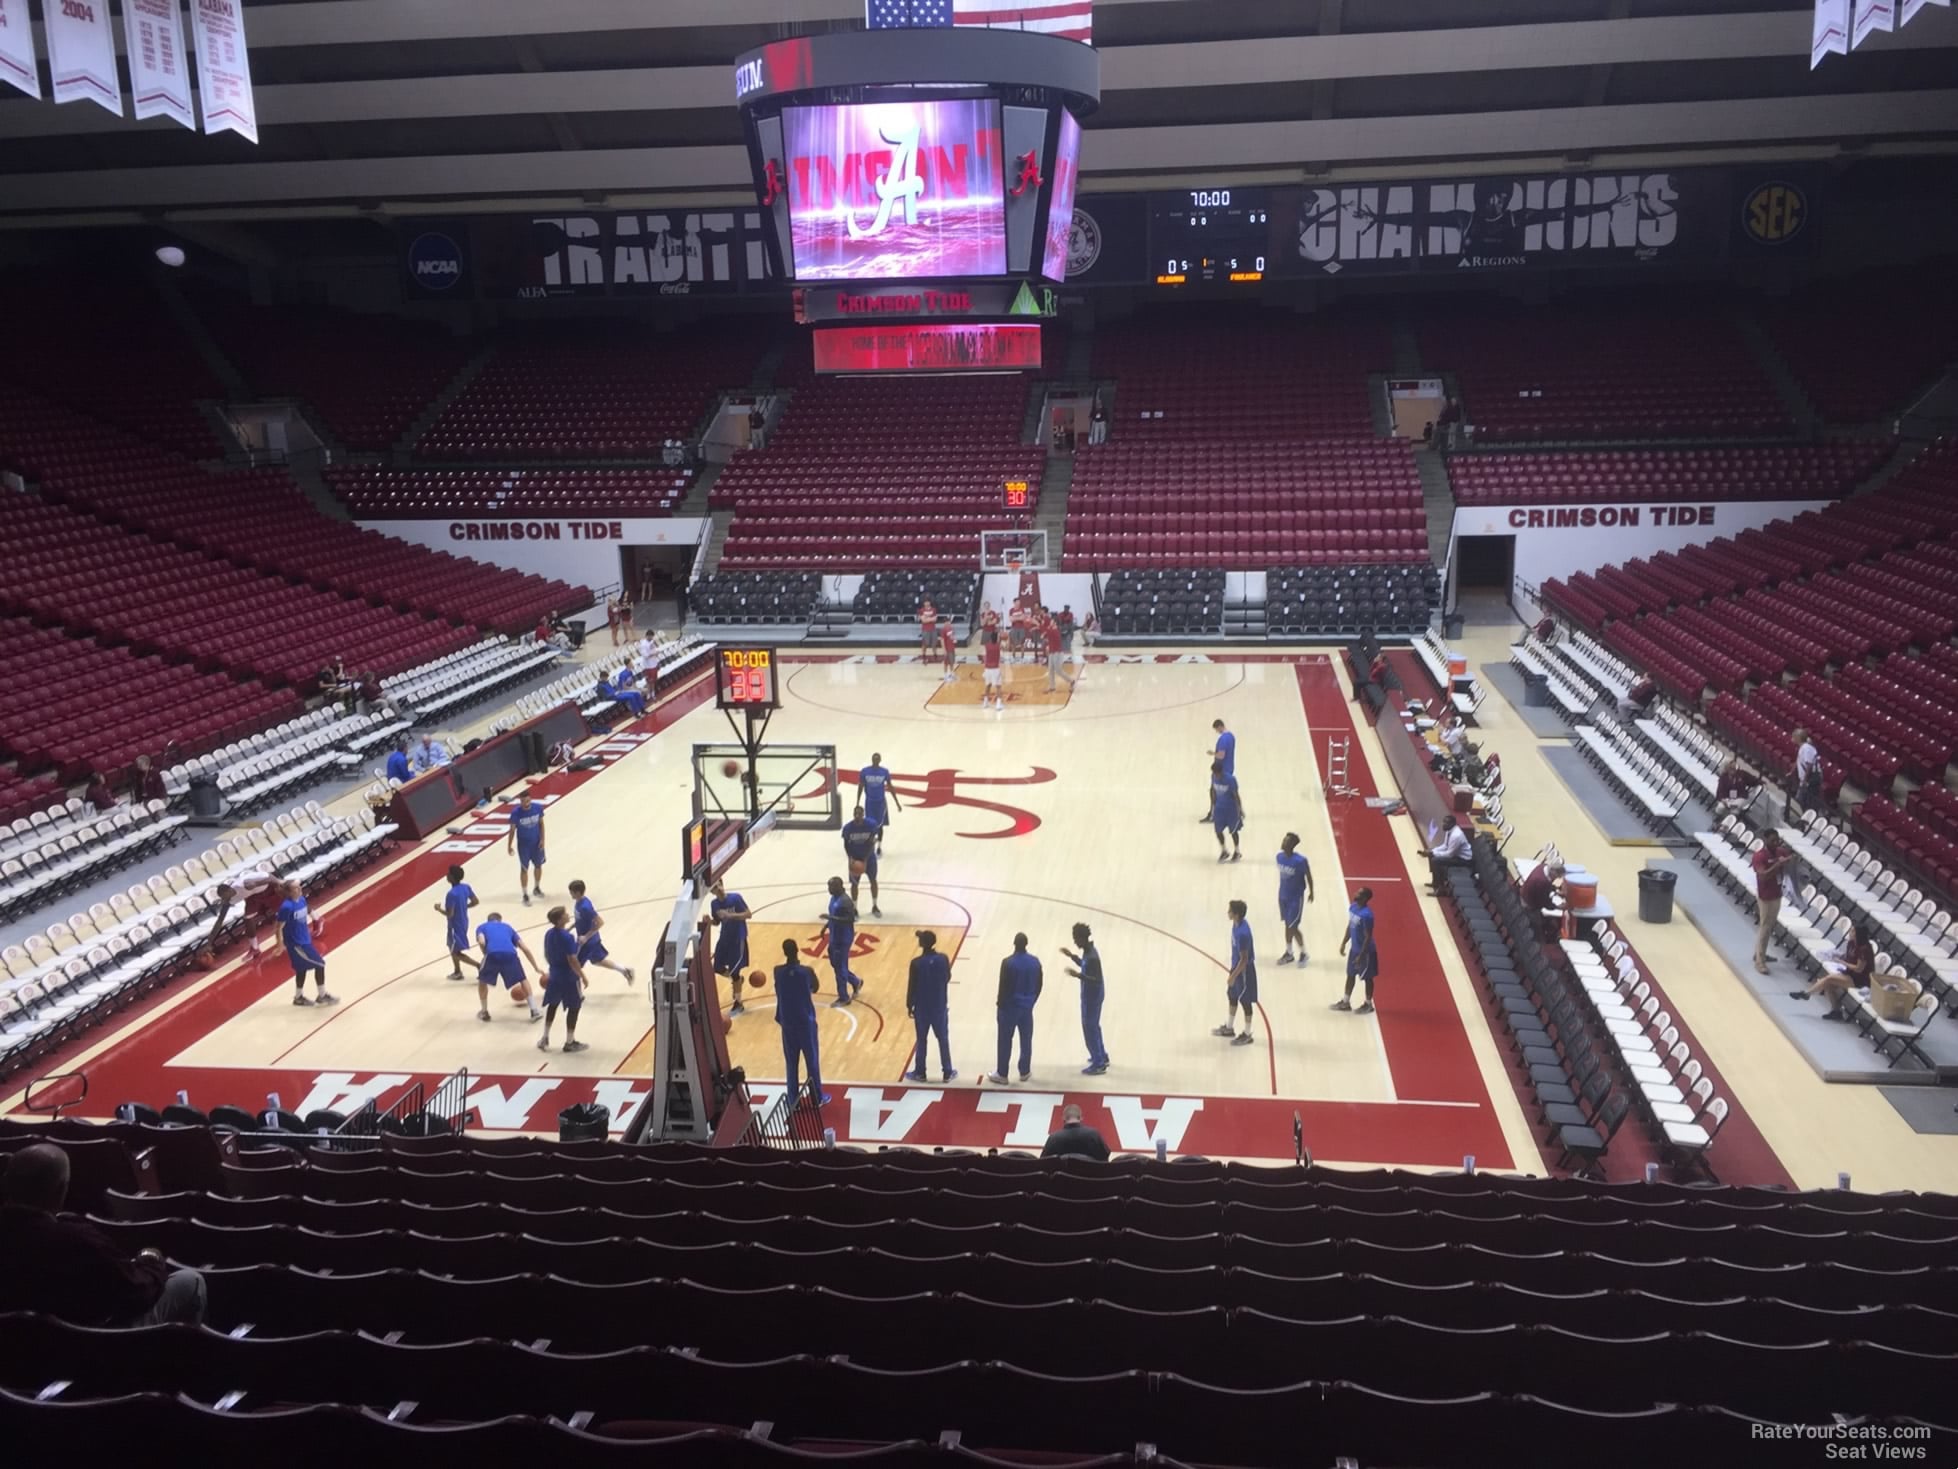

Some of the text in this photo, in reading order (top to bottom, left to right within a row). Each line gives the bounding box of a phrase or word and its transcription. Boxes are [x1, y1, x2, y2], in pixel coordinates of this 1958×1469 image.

[62, 0, 94, 23] 2004
[1190, 190, 1230, 206] 70:00
[1300, 174, 1679, 262] CHAMIONS
[1750, 187, 1801, 239] SEC
[417, 260, 458, 274] NCAA
[517, 287, 548, 298] ALFA
[1007, 491, 1024, 505] 30
[1508, 506, 1715, 528] CRIMSON TIDE
[449, 521, 622, 541] CRIMSON TIDE
[724, 651, 769, 667] 70:00
